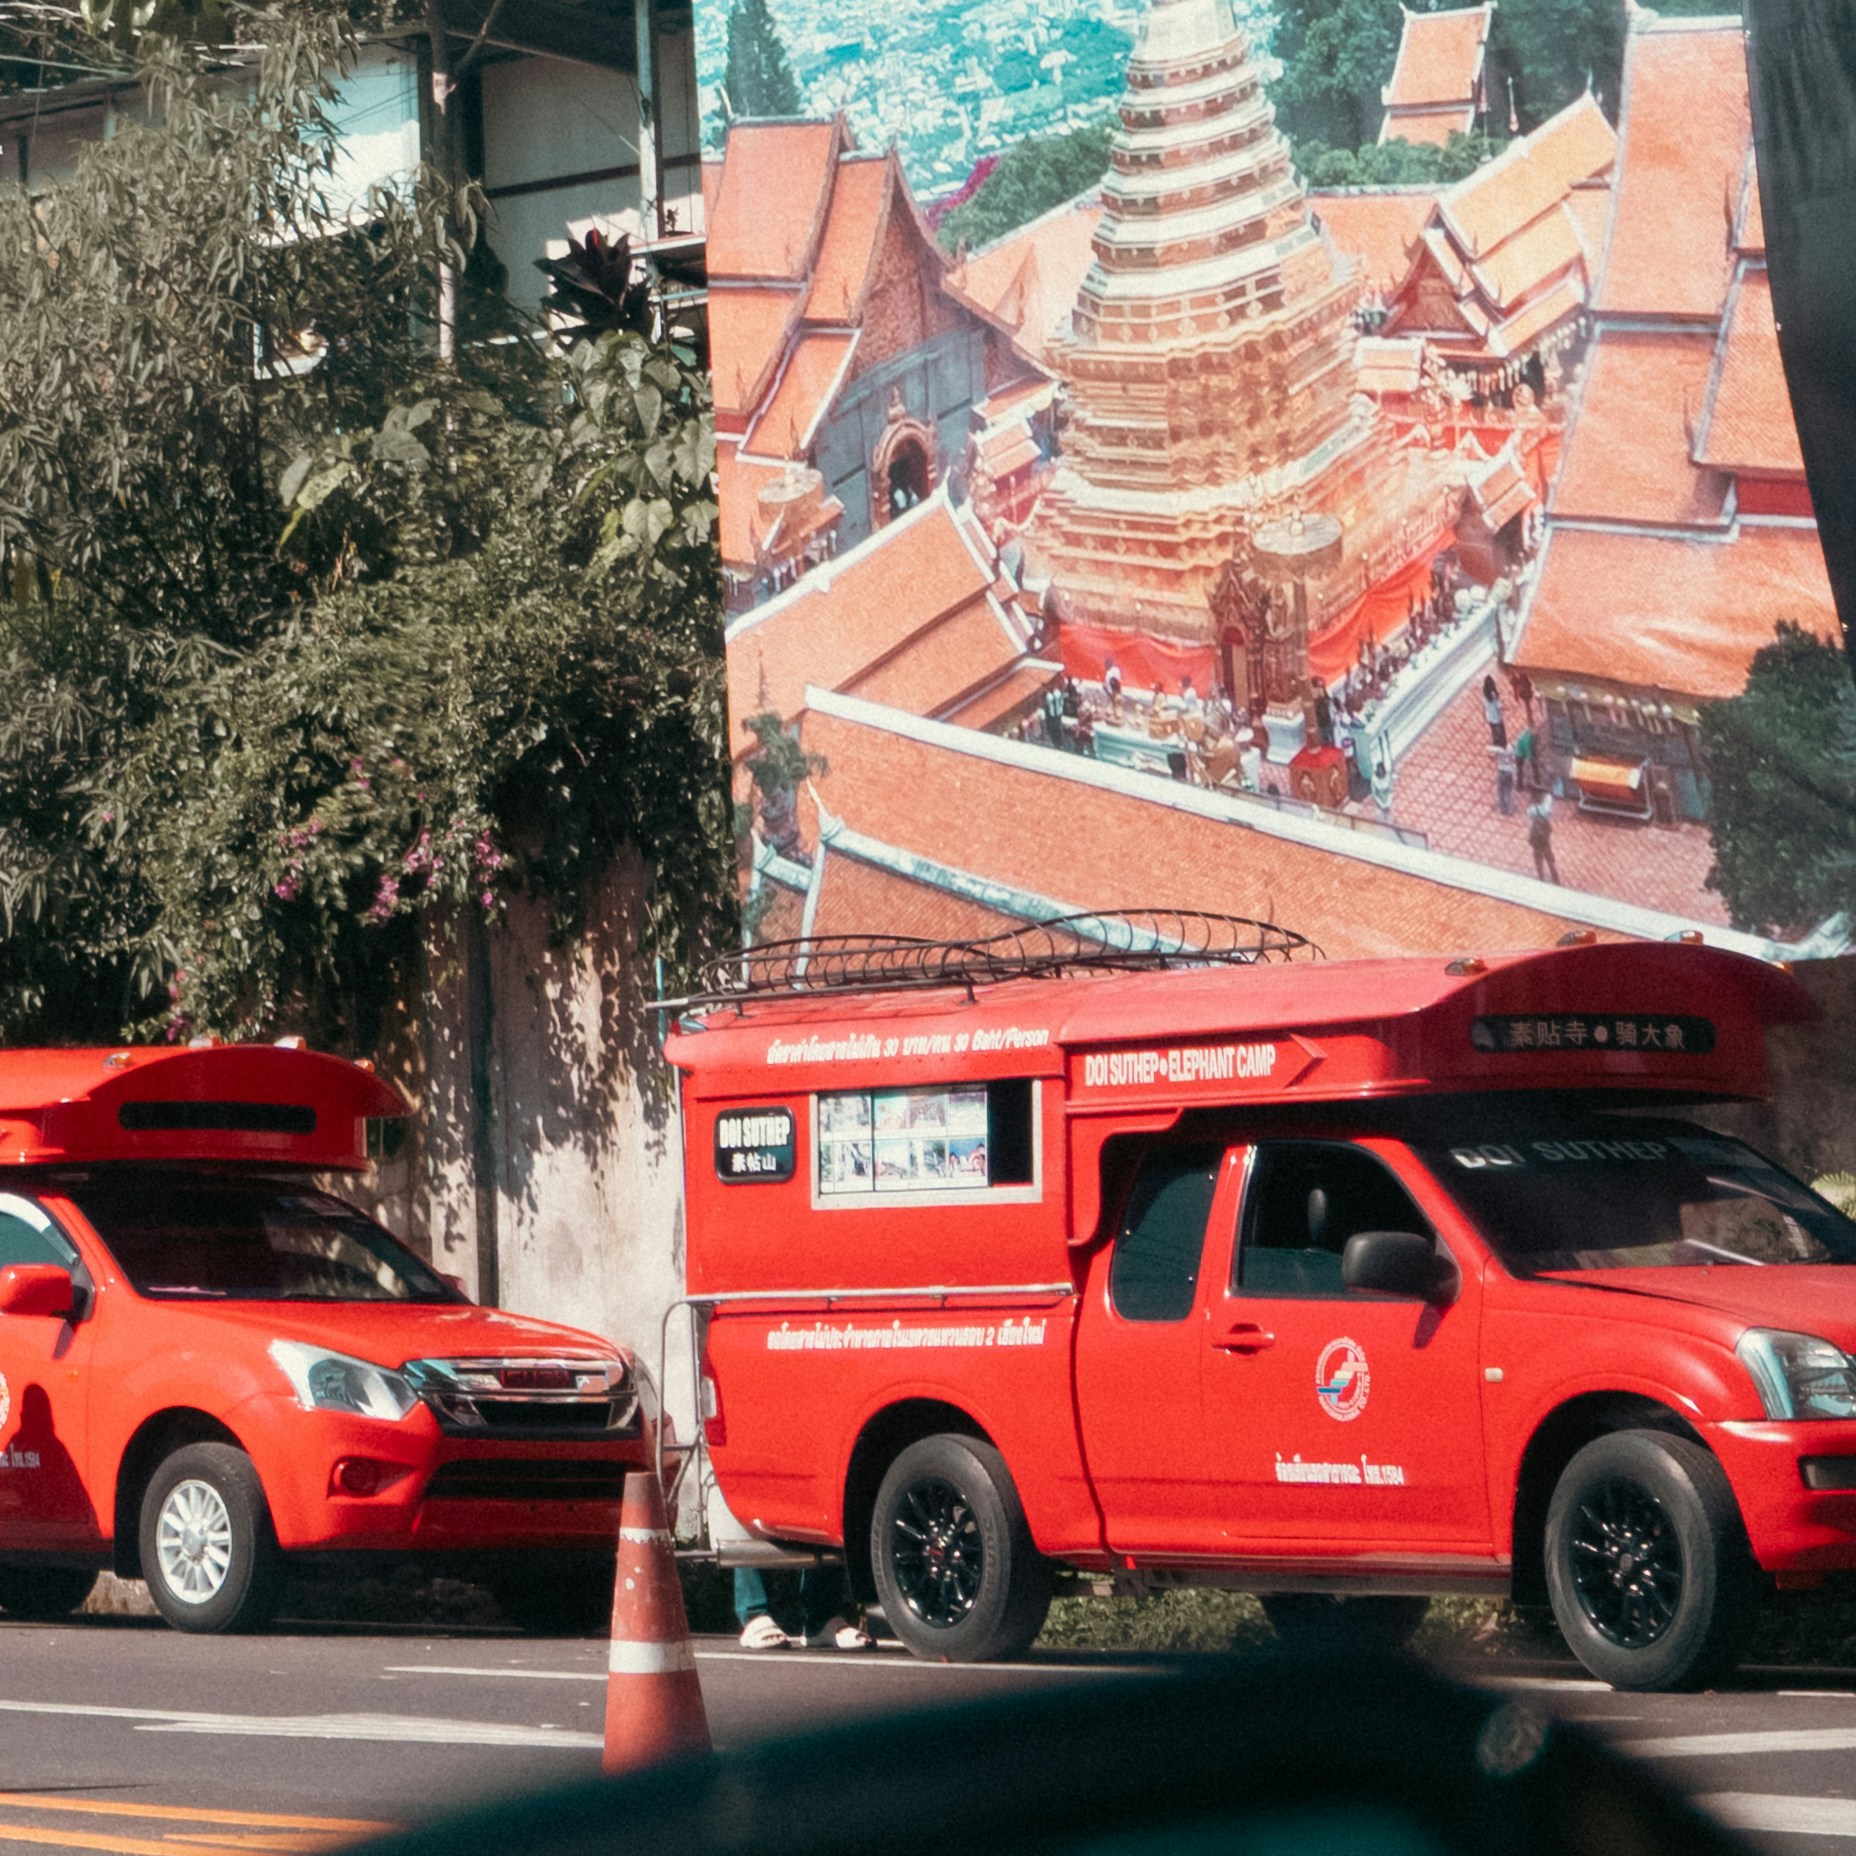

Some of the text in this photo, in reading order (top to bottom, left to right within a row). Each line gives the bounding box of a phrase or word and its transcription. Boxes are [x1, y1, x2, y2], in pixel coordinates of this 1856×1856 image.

[972, 1026, 1050, 1052] Baht/Person
[1085, 1044, 1276, 1087] DOI SUTHEP ELEPHANT CAMP
[719, 1115, 791, 1149] DOI SUTHEP
[1449, 1141, 1669, 1170] DOI SUTHEP
[986, 1329, 995, 1346] 2
